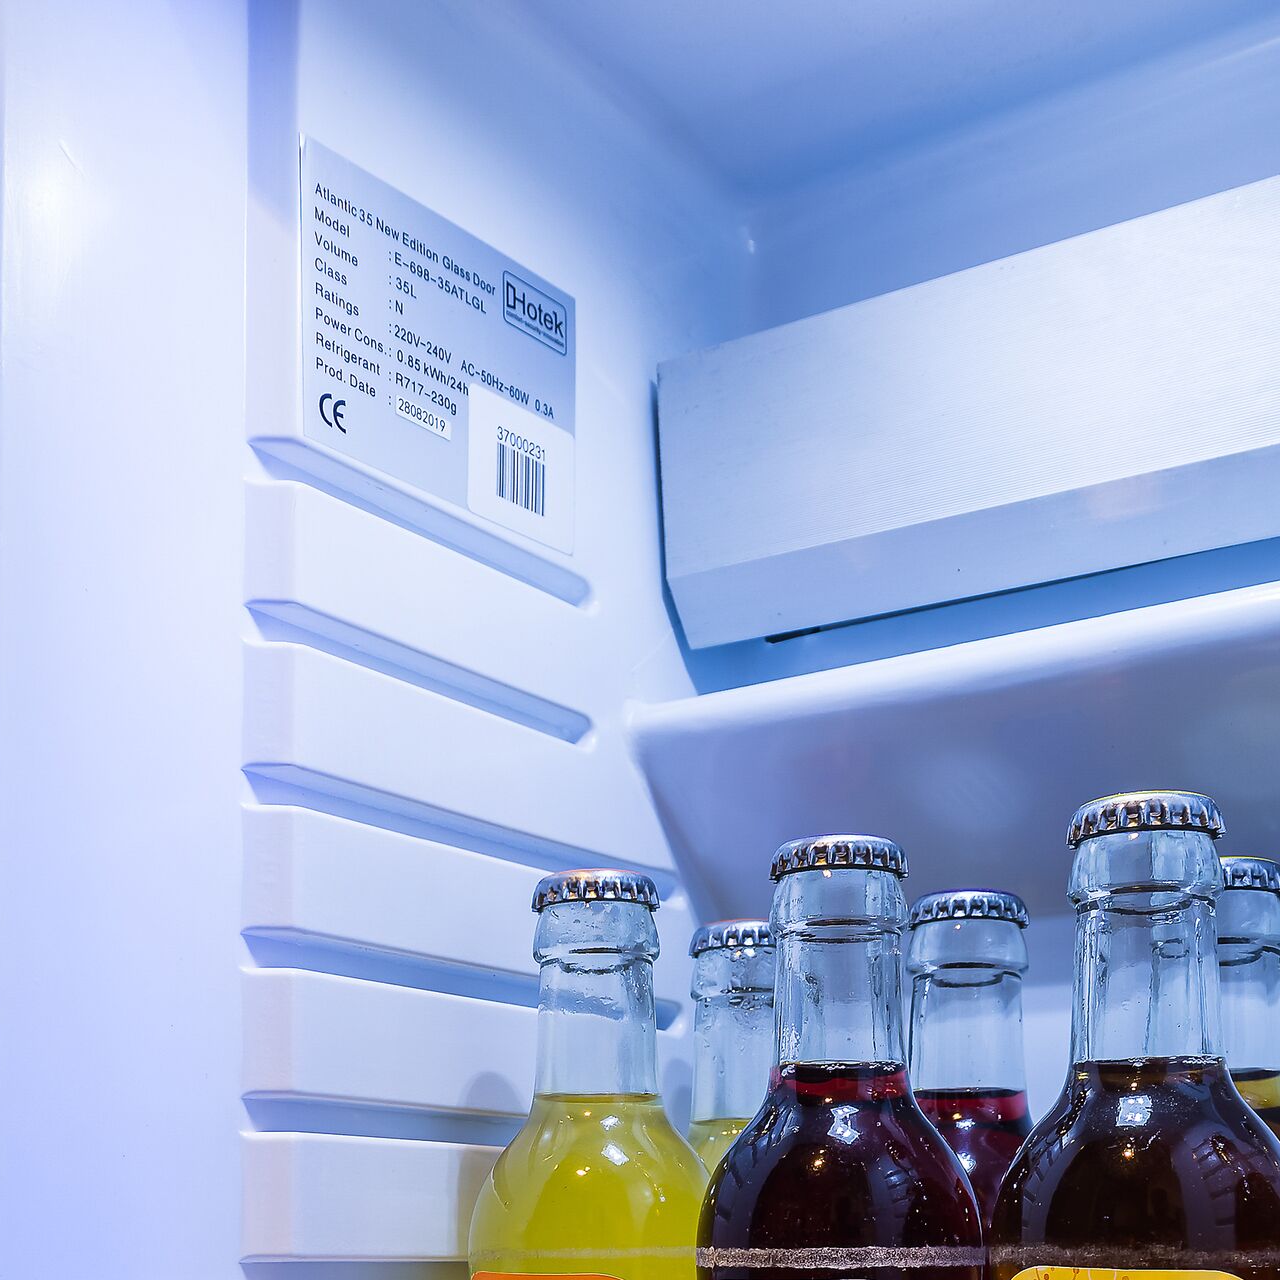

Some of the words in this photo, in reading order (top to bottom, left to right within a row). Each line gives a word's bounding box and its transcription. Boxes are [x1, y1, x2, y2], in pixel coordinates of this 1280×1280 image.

[314, 206, 350, 238] Model
[314, 182, 357, 217] Atlantic
[359, 209, 373, 226] 35
[376, 216, 400, 241] New
[402, 232, 439, 263] Edition
[442, 255, 471, 281] Glass
[473, 272, 496, 296] Door
[314, 231, 359, 267] Volume
[395, 276, 417, 299] 35L
[314, 257, 348, 286] Class
[395, 299, 404, 315] N
[506, 280, 564, 339] Hotek
[315, 282, 360, 316] Ratings
[394, 324, 452, 364] 220V-240V
[460, 359, 530, 406] AC-50Hz-60W
[534, 398, 555, 420] 0.3A
[315, 306, 352, 337] Power
[396, 349, 421, 372] 0.85
[423, 362, 469, 396] kWh/24h
[315, 332, 381, 376] Refrigerant
[395, 372, 457, 416] R717-230g
[315, 356, 347, 384] Prod.
[349, 373, 377, 398] Date
[398, 398, 446, 433] 28082019
[496, 425, 546, 462] 37000231
